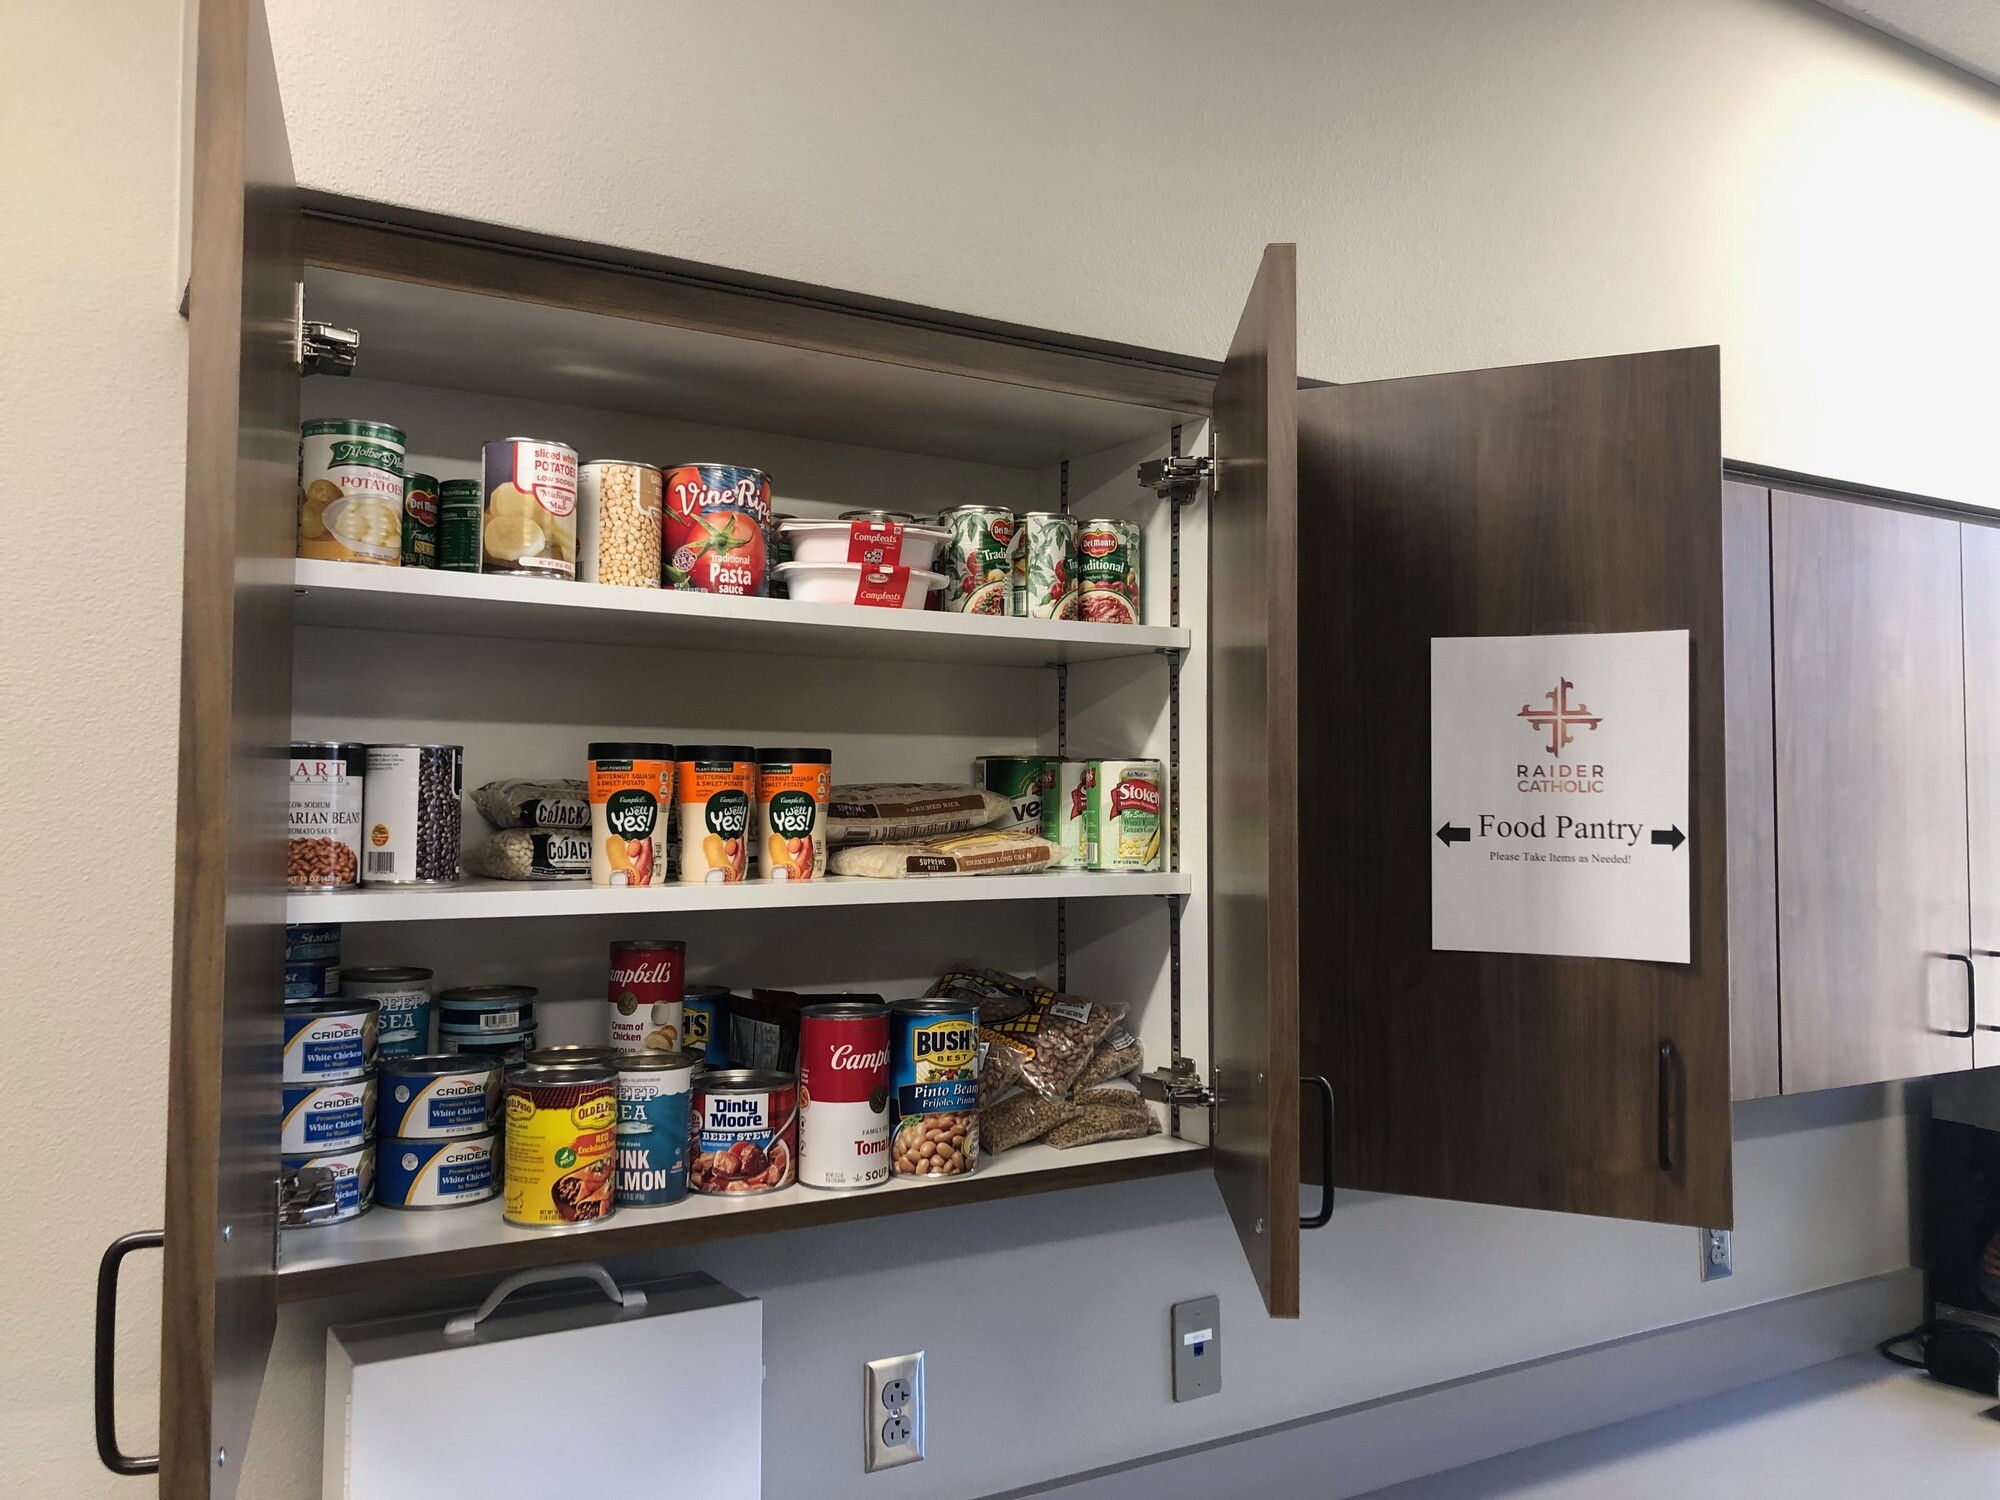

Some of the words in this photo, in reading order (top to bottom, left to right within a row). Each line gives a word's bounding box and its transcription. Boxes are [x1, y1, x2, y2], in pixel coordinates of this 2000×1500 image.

[534, 449, 560, 460] sliced
[537, 475, 554, 483] LOW
[341, 476, 403, 496] POTATOES
[540, 488, 572, 507] Michigan
[675, 482, 735, 516] Vine
[548, 501, 568, 511] Made
[994, 526, 1004, 534] Del
[853, 532, 897, 544] Compleats
[1083, 539, 1095, 549] Del
[1094, 539, 1116, 548] Monte
[711, 553, 750, 565] traditional
[709, 563, 752, 586] Pasta
[718, 583, 744, 595] sauce
[860, 591, 901, 602] Compleats
[295, 762, 345, 776] ART
[1517, 764, 1604, 778] RAIDER
[1517, 780, 1604, 793] CATHOLIC
[1012, 801, 1043, 822] ve
[288, 812, 329, 824] ARIAN
[332, 812, 361, 825] BEANS
[1478, 814, 1547, 838] Food
[1555, 815, 1643, 846] Pantry
[919, 858, 947, 866] SUPREME
[1490, 851, 1520, 861] Please
[1522, 852, 1546, 862] Take
[1550, 853, 1576, 863] Items
[1592, 854, 1631, 865] Needed!
[609, 963, 671, 987] ampbell's
[378, 1014, 415, 1029] SEA
[611, 1021, 634, 1031] Cream
[634, 1022, 644, 1031] of
[311, 1029, 359, 1040] CRIDER
[612, 1032, 642, 1041] Chicken
[917, 1029, 979, 1057] BUSH'S
[307, 1054, 332, 1062] White
[333, 1050, 362, 1060] Chicken
[938, 1053, 968, 1062] BEST
[436, 1085, 482, 1097] CRIDER
[617, 1085, 659, 1101] EEP
[915, 1086, 949, 1099] Pinto
[953, 1083, 979, 1096] Beans
[313, 1097, 360, 1110] CRIDER
[714, 1099, 758, 1115] Dinty
[922, 1098, 954, 1108] Frijoles
[956, 1096, 976, 1105] Pintos
[432, 1110, 456, 1118] White
[457, 1106, 485, 1116] Chicken
[620, 1105, 648, 1120] EA
[309, 1123, 334, 1132] White
[335, 1119, 362, 1129] Chicken
[710, 1114, 762, 1127] Moore
[702, 1132, 736, 1141] BEEF
[736, 1130, 772, 1140] STEW
[862, 1127, 882, 1135] FAMILY
[595, 1133, 609, 1143] RED
[577, 1141, 607, 1154] Enchilada
[446, 1149, 488, 1163] CRIDER
[560, 1156, 574, 1167] MILD
[442, 1177, 465, 1185] White
[466, 1171, 491, 1181] Chicken
[616, 1169, 666, 1191] LMON
[865, 1166, 888, 1182] SOUP
[335, 1190, 358, 1199] hicken
